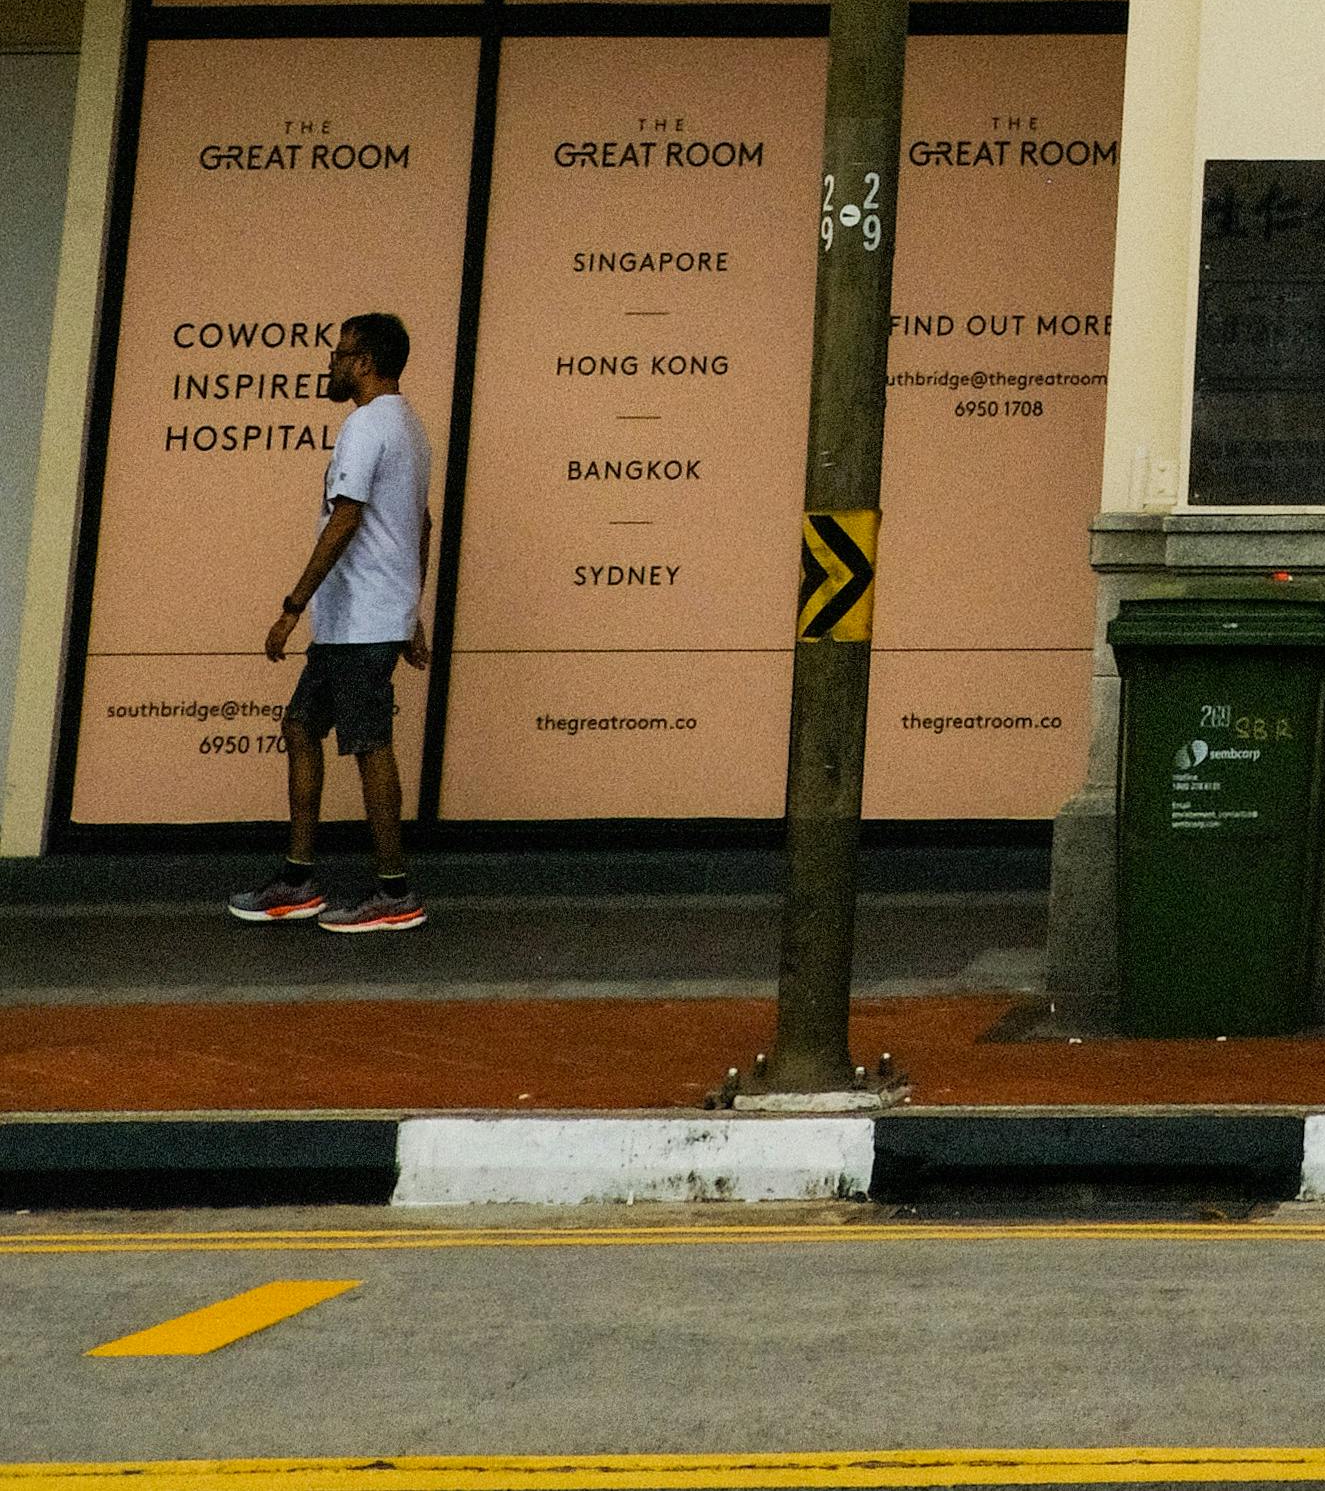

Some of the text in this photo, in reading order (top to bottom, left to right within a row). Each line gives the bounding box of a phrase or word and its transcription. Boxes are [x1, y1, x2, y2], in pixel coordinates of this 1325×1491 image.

[285, 121, 332, 134] THE
[638, 118, 684, 132] THE
[992, 117, 1037, 131] THE
[200, 145, 409, 170] GREAT ROOM
[554, 142, 763, 168] GREAT ROOM
[909, 141, 1117, 166] GREAT ROOM
[573, 252, 729, 272] SINGAPORE
[889, 316, 954, 337] FIND
[967, 315, 1024, 337] OUT
[557, 356, 729, 376] HONG KONG
[173, 374, 333, 400] INSPIRED
[955, 401, 1043, 417] 6950 1708
[568, 461, 701, 480] BANGKOK
[574, 565, 681, 586] SYDNEY
[536, 715, 697, 735] thegreatroom.co
[902, 713, 1062, 734] thegreatroom.co
[200, 736, 249, 754] 6950
[1210, 748, 1261, 762] sembcorp
